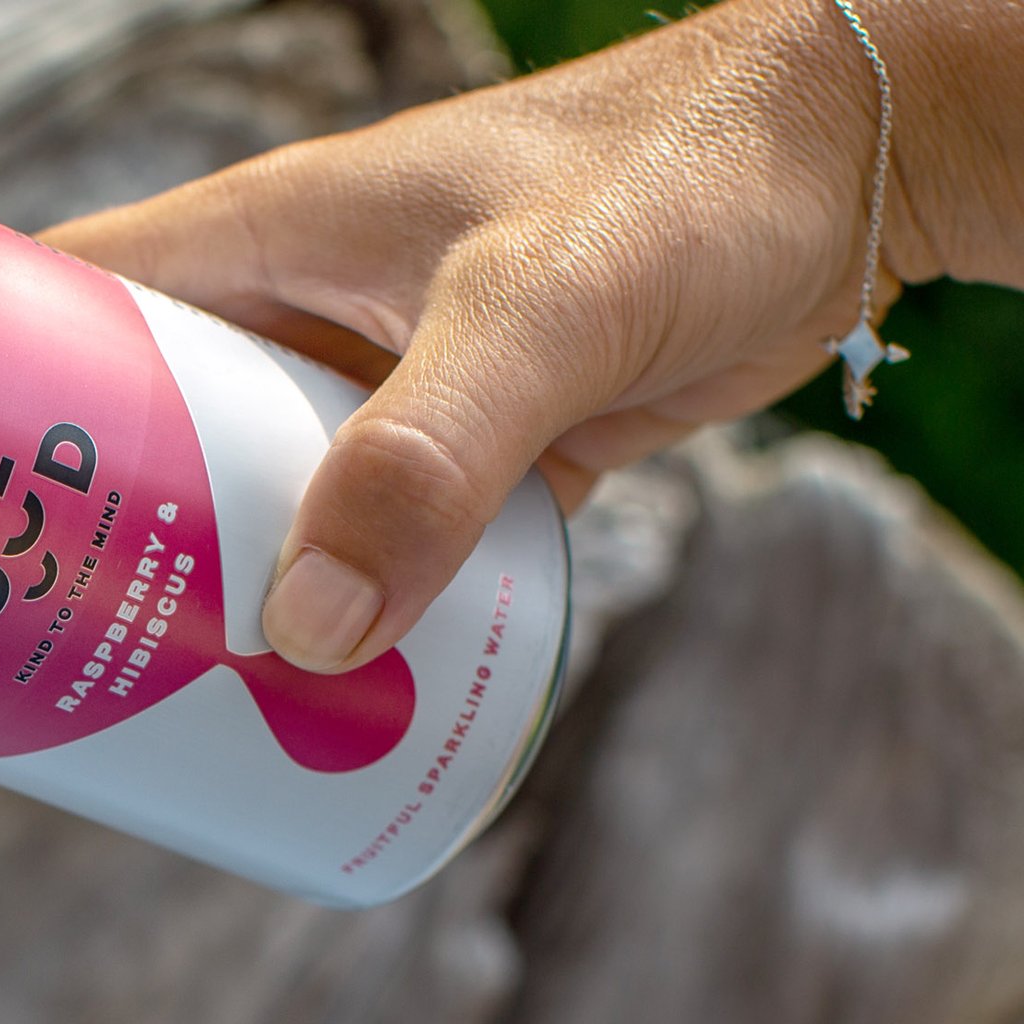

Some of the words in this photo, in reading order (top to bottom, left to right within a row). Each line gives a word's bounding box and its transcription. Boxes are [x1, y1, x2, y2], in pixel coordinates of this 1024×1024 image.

[15, 639, 52, 683] KIND
[49, 607, 73, 634] TO
[68, 555, 98, 599] THE
[91, 491, 122, 550] MIND
[56, 532, 165, 712] RASPBERRY
[157, 502, 178, 524] &
[108, 553, 195, 697] HIBISCUS
[341, 801, 422, 874] FRUITFUL
[418, 665, 491, 795] SPARKLING
[484, 573, 515, 657] WATER
